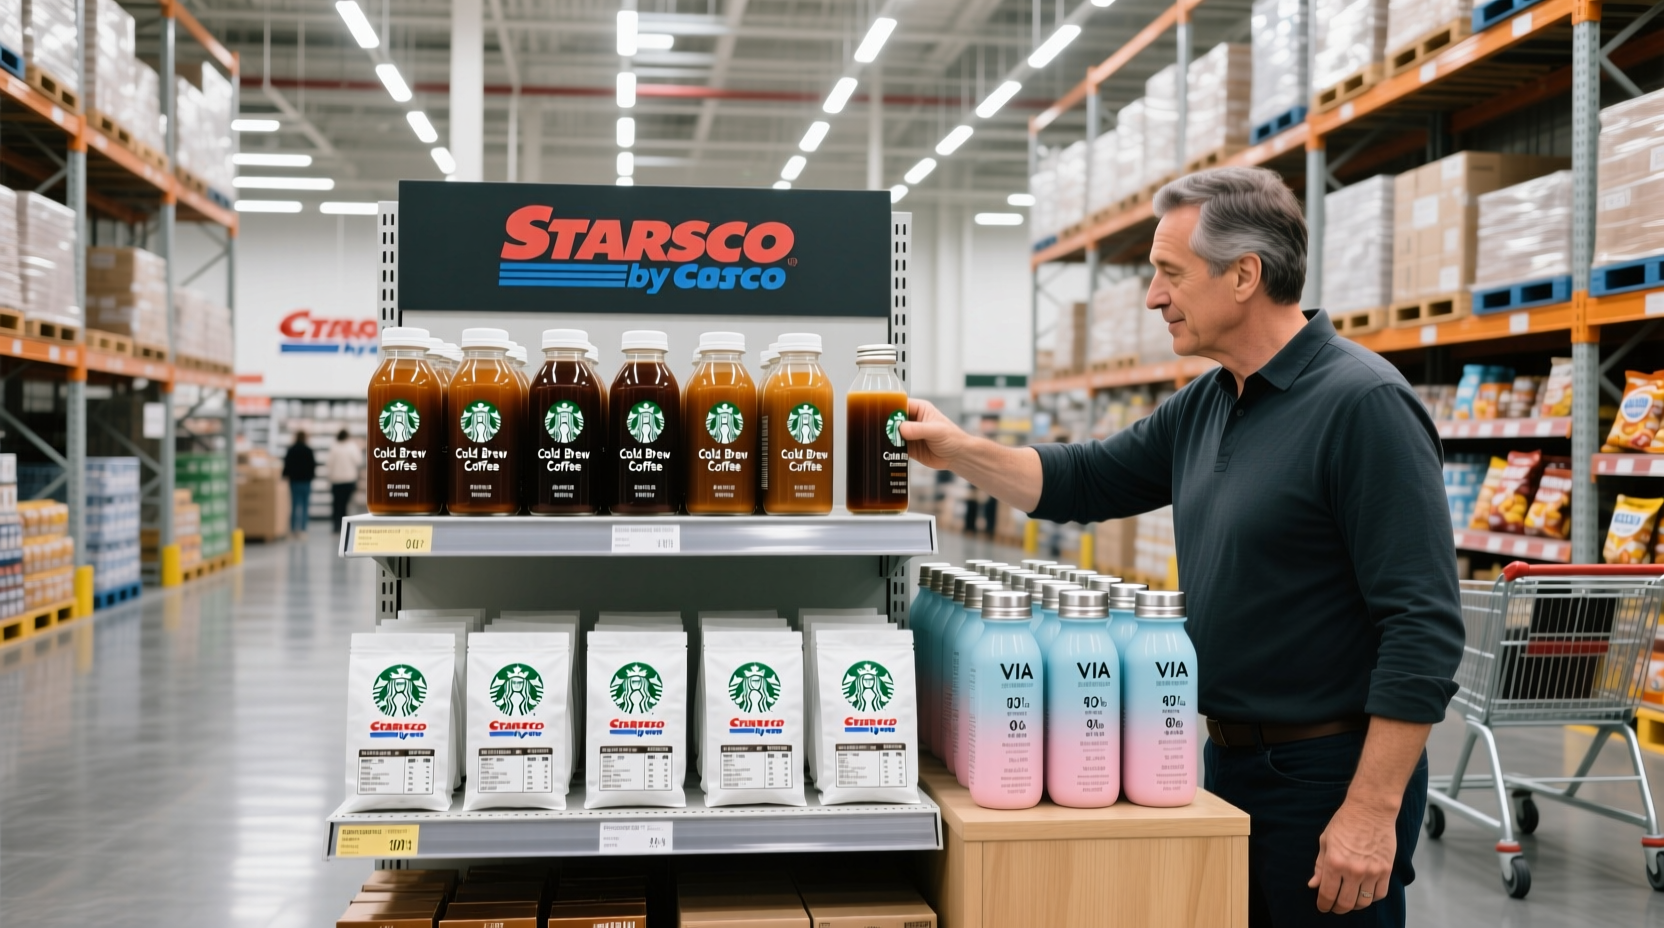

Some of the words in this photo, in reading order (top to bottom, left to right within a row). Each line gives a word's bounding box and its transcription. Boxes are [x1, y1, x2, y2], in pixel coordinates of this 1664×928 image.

[500, 204, 795, 264] STARSCO
[627, 263, 671, 294] by
[373, 446, 397, 459] Cold
[537, 447, 560, 459] Cold
[619, 447, 642, 459] Cold
[1000, 662, 1033, 680] VIA
[1077, 662, 1111, 679] VIA
[1155, 661, 1188, 679] VIA
